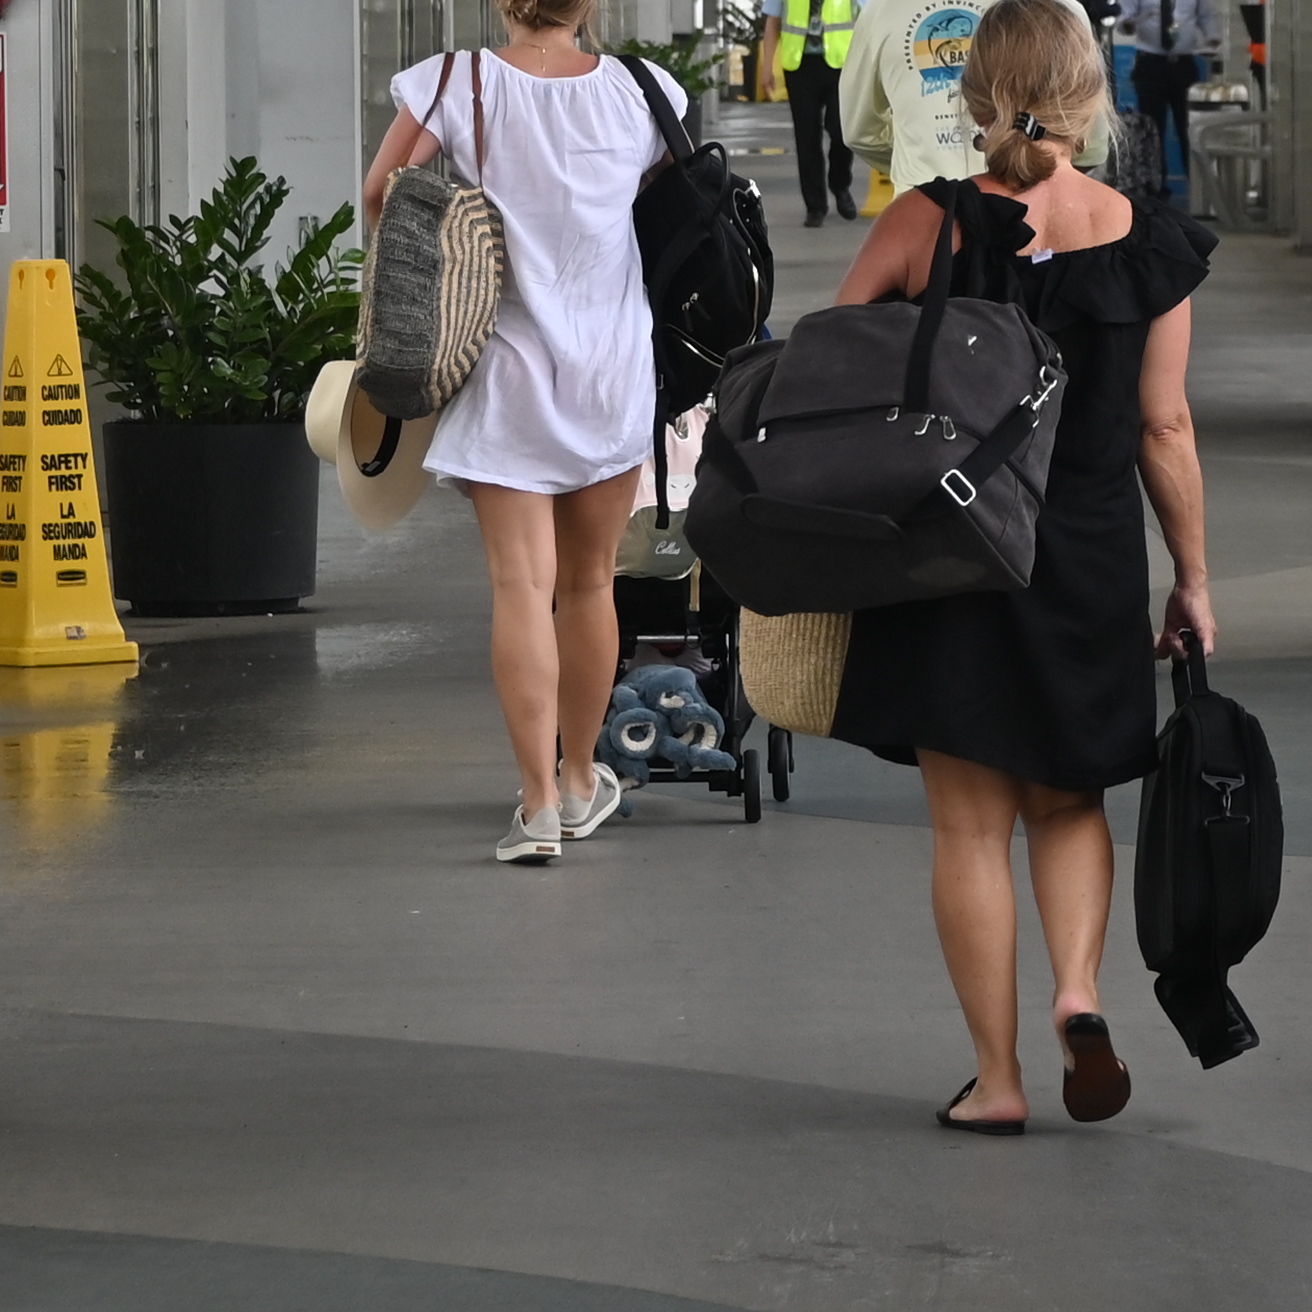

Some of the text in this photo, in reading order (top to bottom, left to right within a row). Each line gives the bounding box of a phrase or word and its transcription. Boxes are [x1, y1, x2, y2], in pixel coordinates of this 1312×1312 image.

[41, 384, 81, 401] CAUTION
[42, 408, 83, 426] CUIDADO
[0, 454, 27, 472] SAFETY
[41, 452, 88, 471] SAFETY
[1, 475, 23, 492] FIRST
[48, 474, 83, 492] FIRST
[6, 503, 16, 520] LA
[60, 502, 76, 519] LA
[42, 521, 96, 541] SEGURIDAD
[53, 543, 88, 561] MANDA
